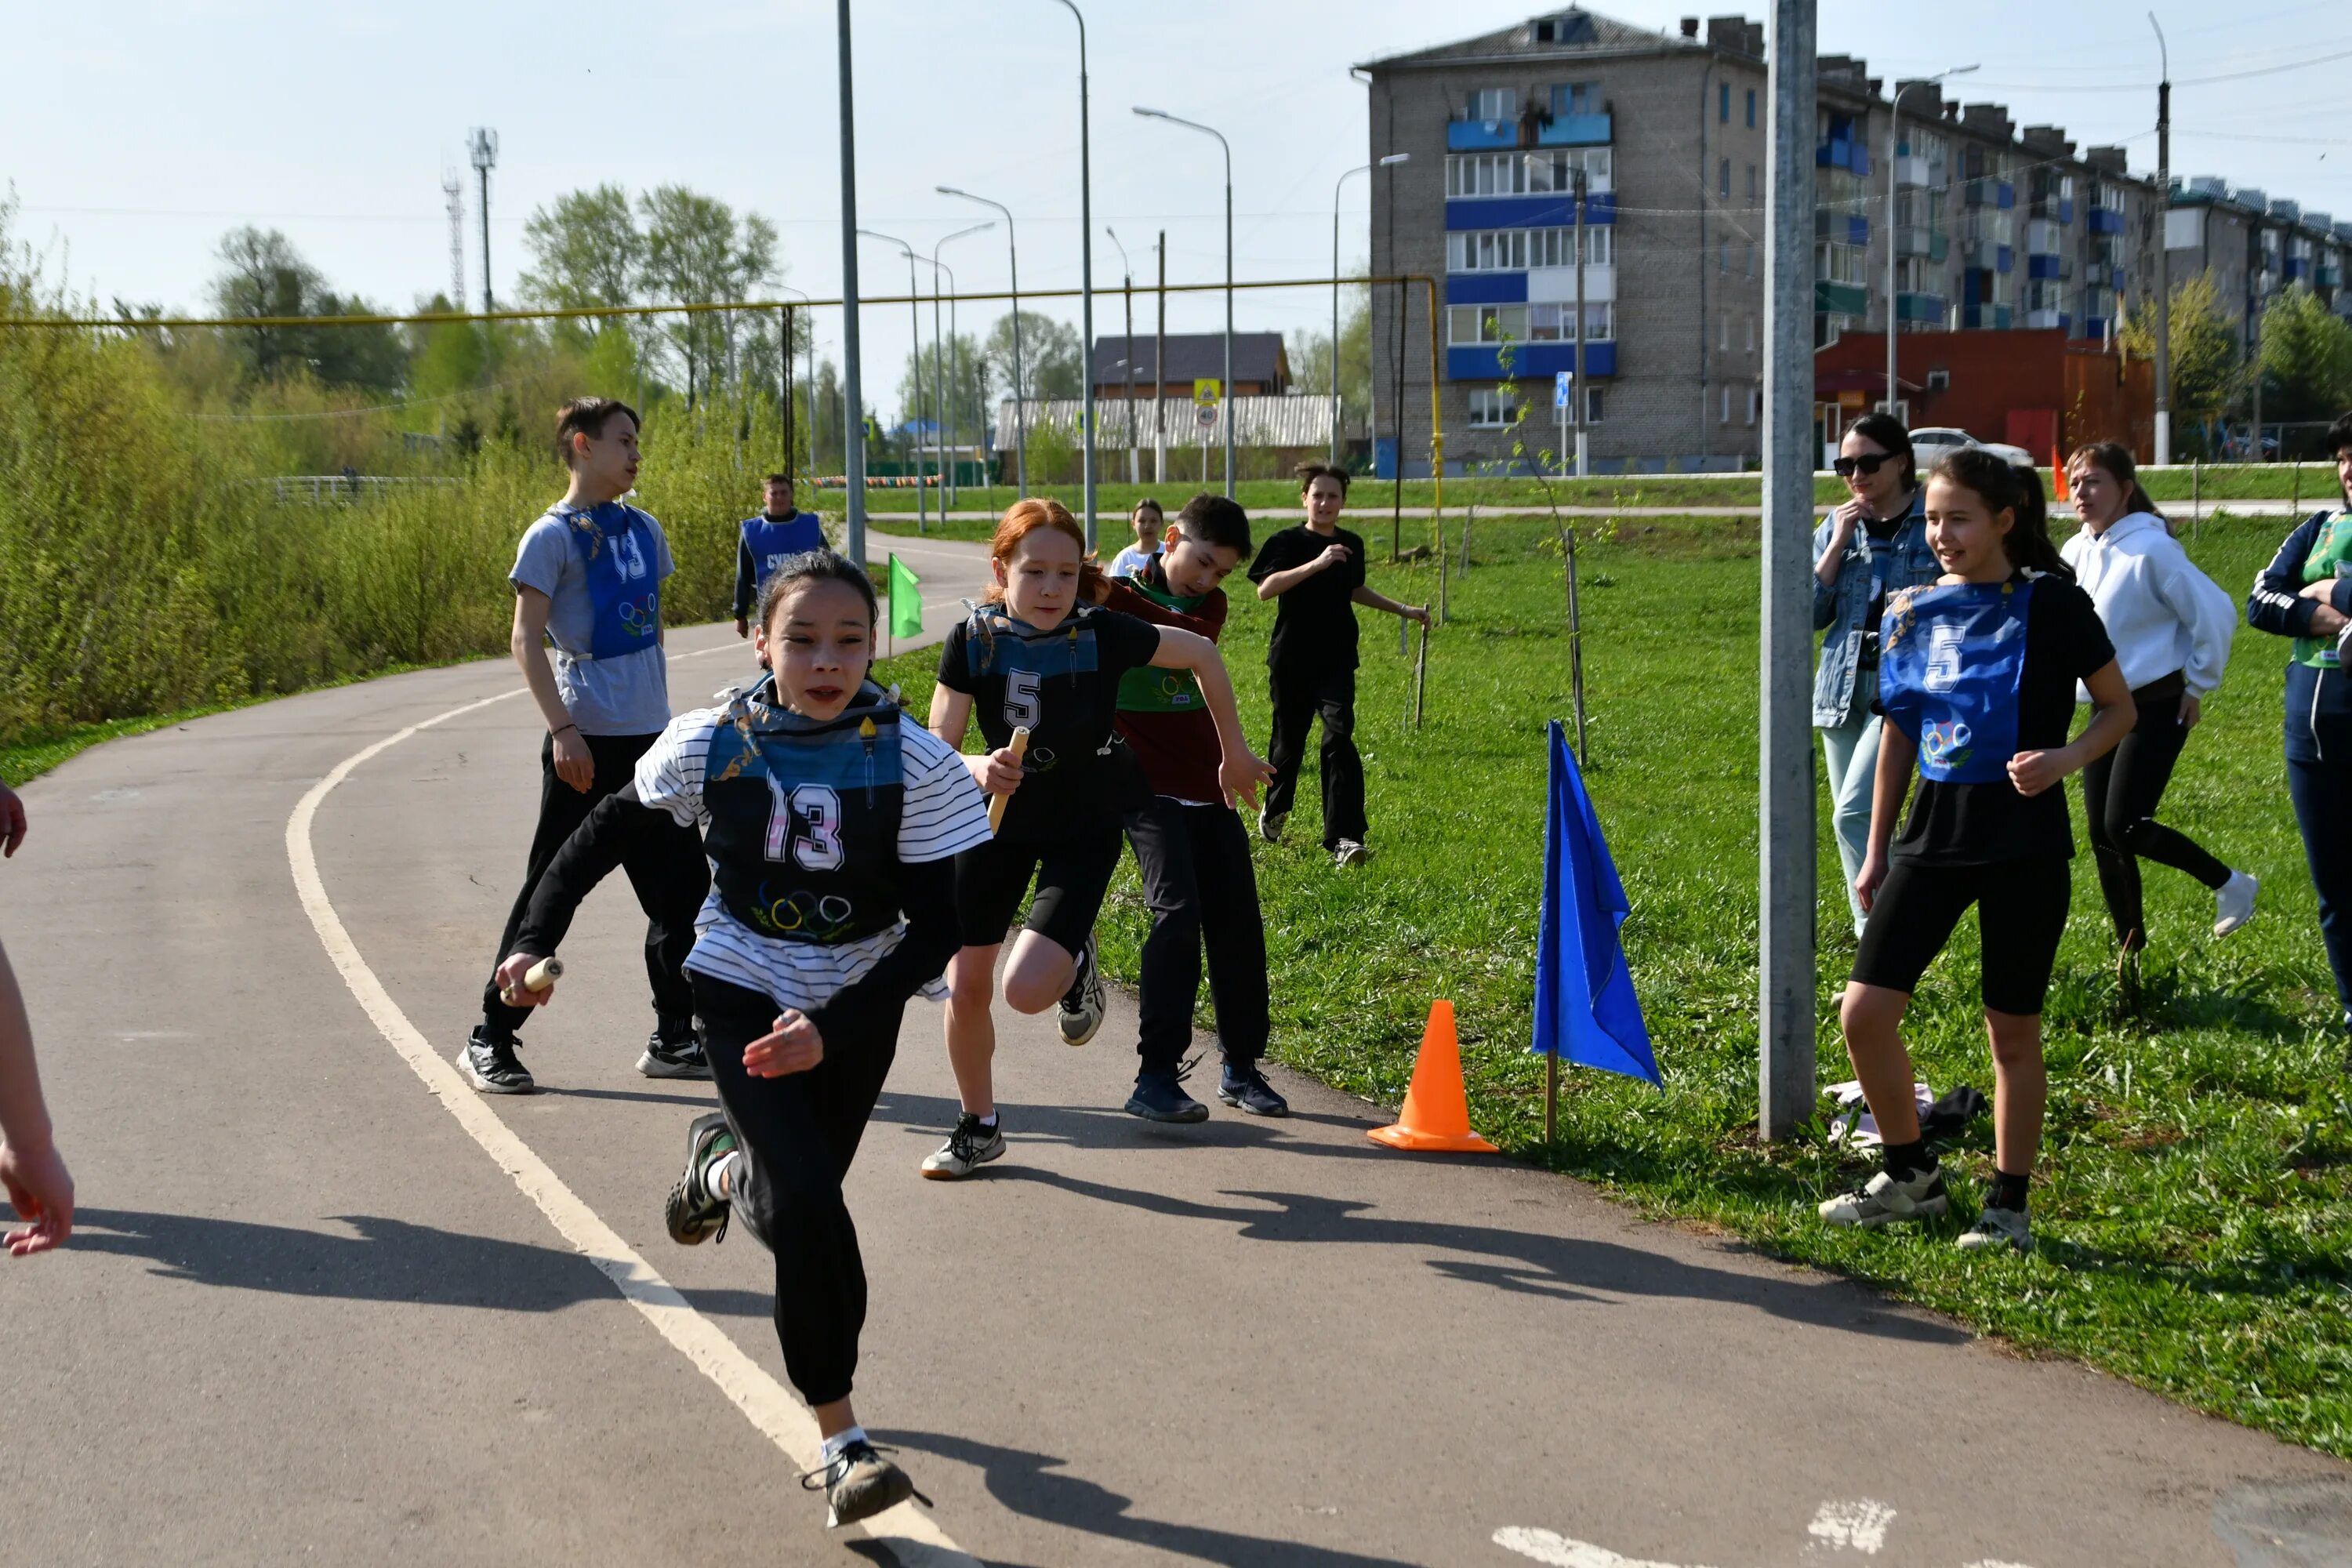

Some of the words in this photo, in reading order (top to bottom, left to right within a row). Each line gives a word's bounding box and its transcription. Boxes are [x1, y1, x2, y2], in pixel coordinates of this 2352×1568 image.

[1200, 410, 1213, 419] 40
[608, 527, 646, 584] 13
[1922, 624, 1966, 693] 5
[1004, 667, 1040, 731] 5
[764, 768, 844, 871] 13
